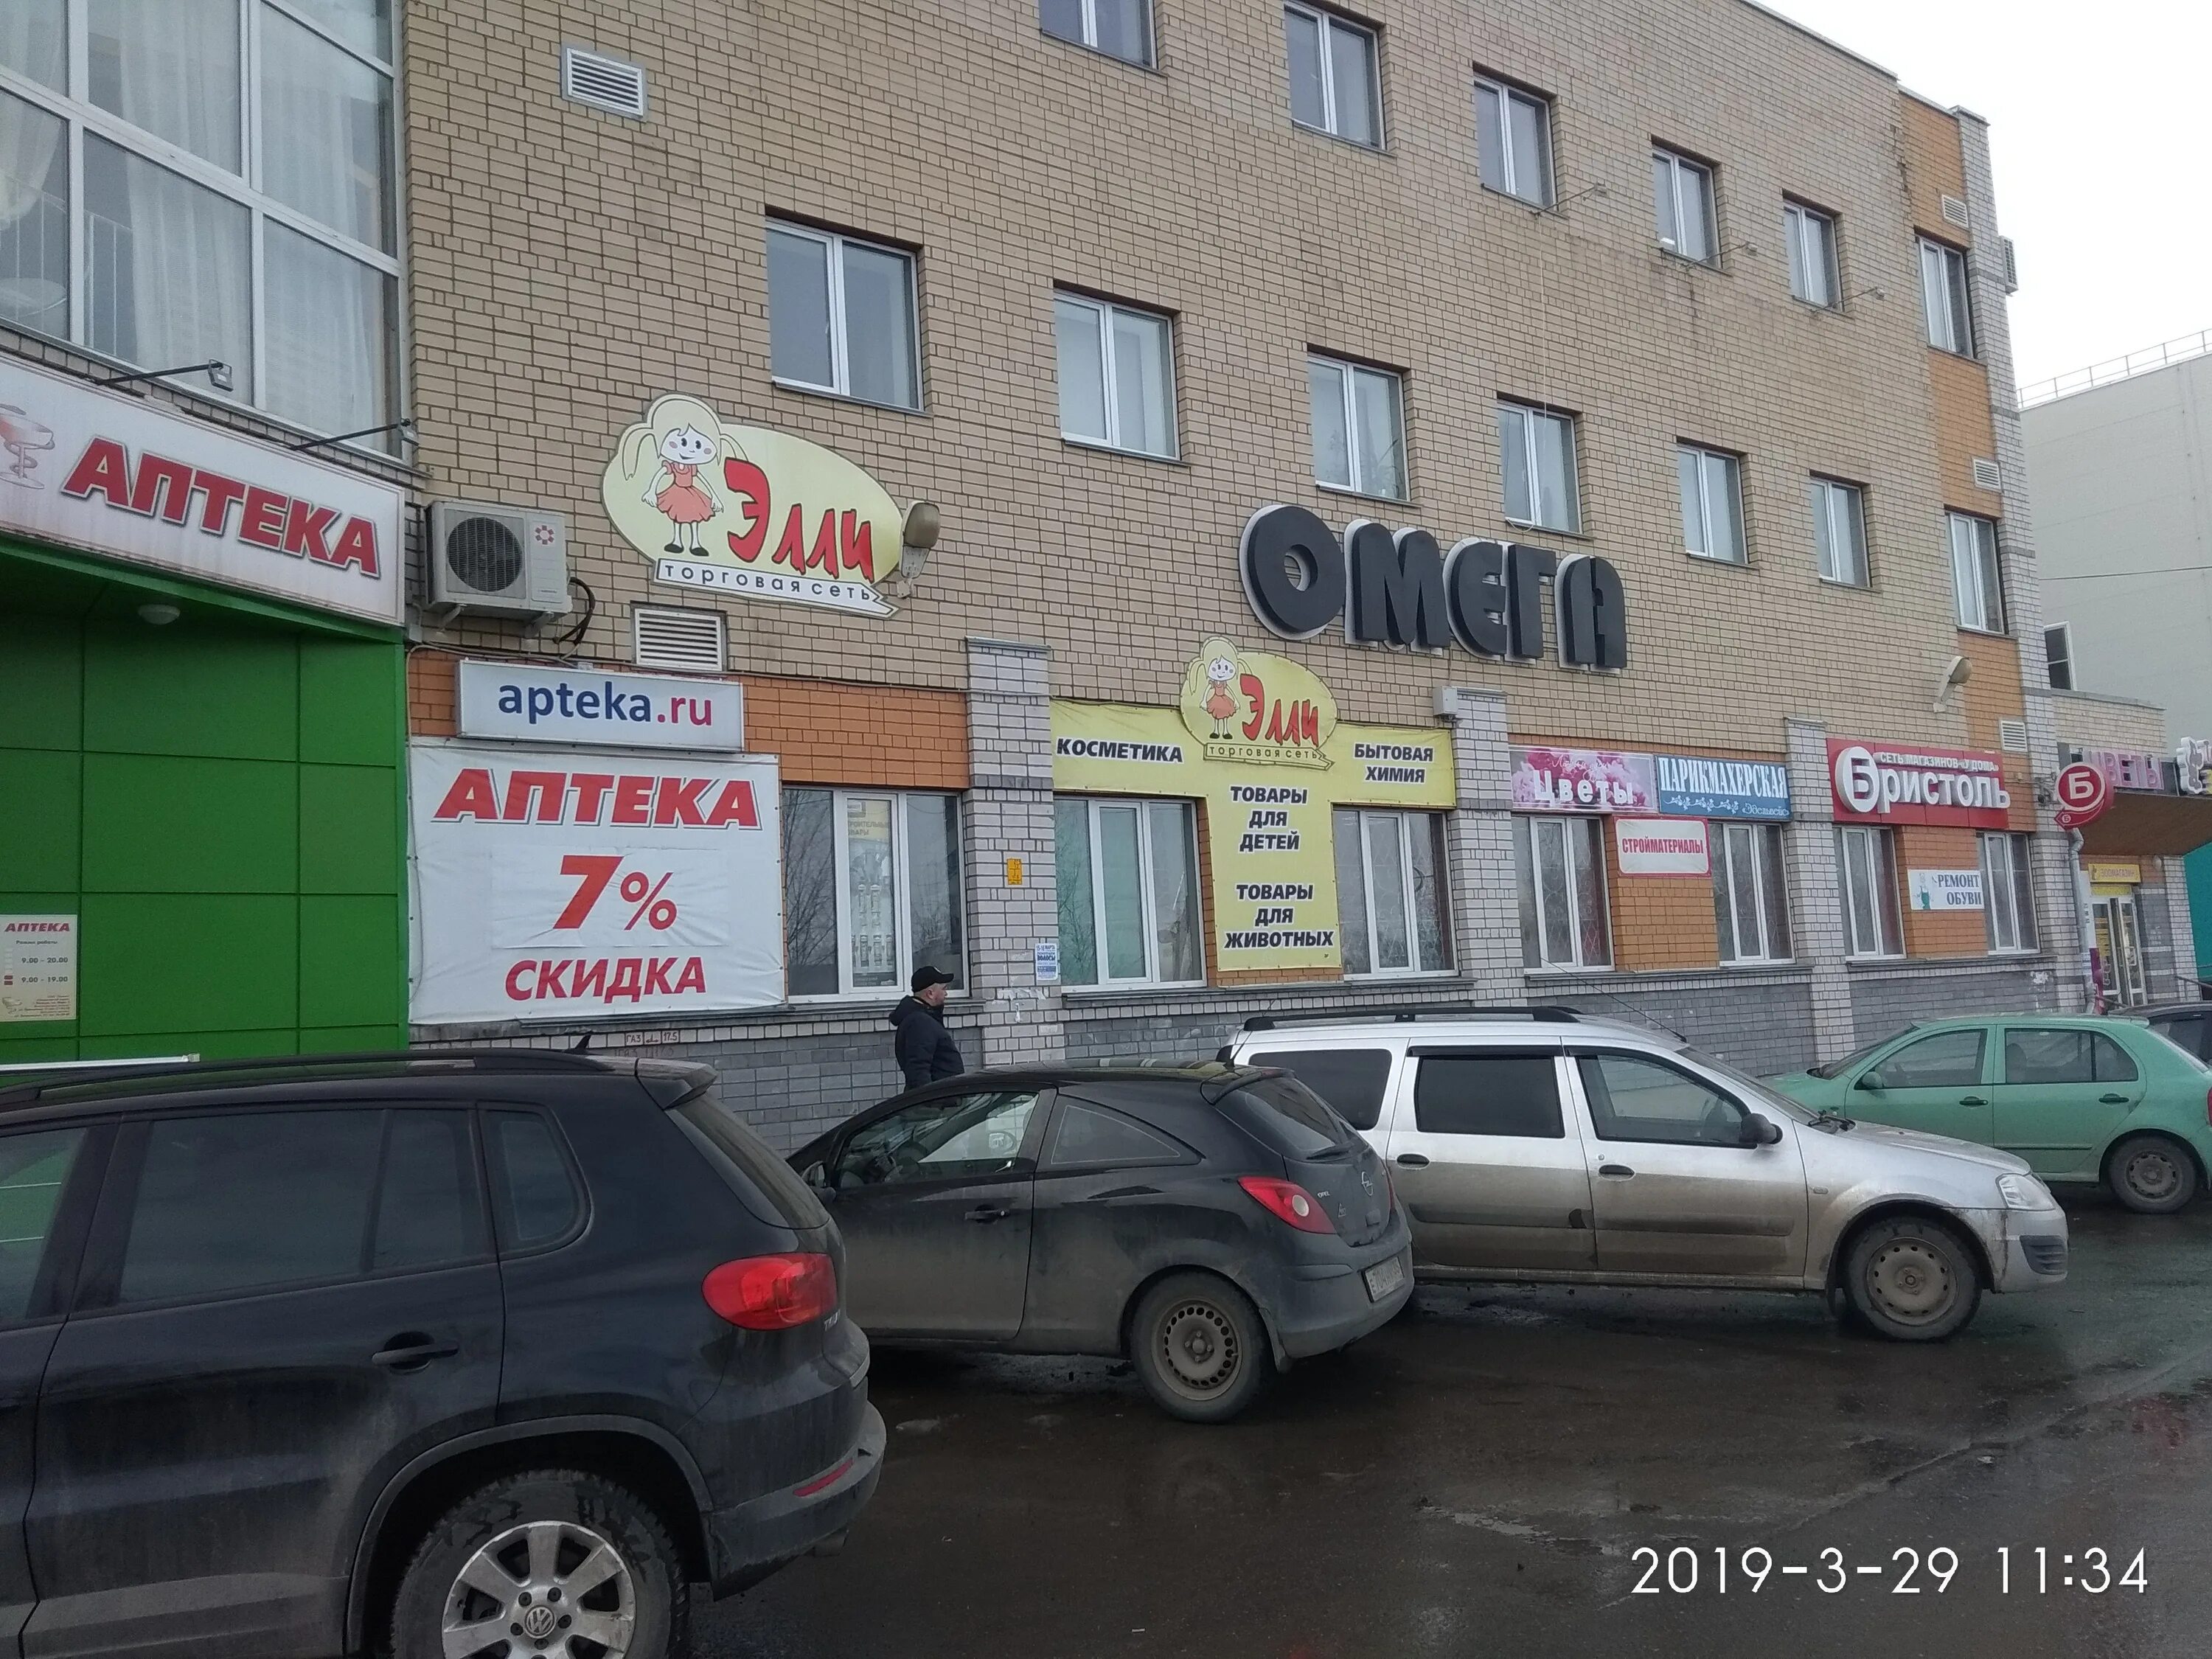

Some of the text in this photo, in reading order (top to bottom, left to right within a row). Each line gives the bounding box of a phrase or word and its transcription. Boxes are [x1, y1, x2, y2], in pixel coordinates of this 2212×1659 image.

[60, 434, 380, 577] АПТЕКА
[664, 566, 871, 600] торговая сеть
[1239, 504, 1627, 674] ОМЕГА
[498, 681, 712, 726] apteka.ru
[1056, 738, 1183, 763] КОСМЕТИКА
[1209, 746, 1317, 759] торговая сеть
[1354, 743, 1433, 762] БЫТОВАЯ
[1880, 751, 1904, 764] СЕТЬ
[1905, 754, 1958, 768] МАГАЗИНОВ
[1365, 766, 1426, 783] ХИМИЯ
[1659, 757, 1789, 799] ПАРИКМАХЕРСКАЯ
[1533, 770, 1634, 808] Цветы
[2068, 771, 2093, 799] Б
[431, 768, 762, 830] АПТЕКА
[1230, 786, 1307, 804] ТОВАРЫ
[1248, 811, 1287, 830] ДЛЯ
[1239, 832, 1300, 852] ДЕТЕЙ
[1622, 835, 1704, 854] СТРОЙМАТЕРИАЛЫ
[1938, 874, 1979, 888] РЕМОНТ
[552, 854, 678, 931] 7%
[1236, 883, 1313, 901] ТОВАРЫ
[1947, 892, 1982, 905] ОБУВИ
[1255, 908, 1293, 927] ДЛЯ
[4, 923, 69, 932] АПТЕКА
[1223, 930, 1334, 949] ЖИВОТНЫХ
[505, 957, 706, 1004] СКИДКА
[626, 1034, 641, 1043] ГАЗ
